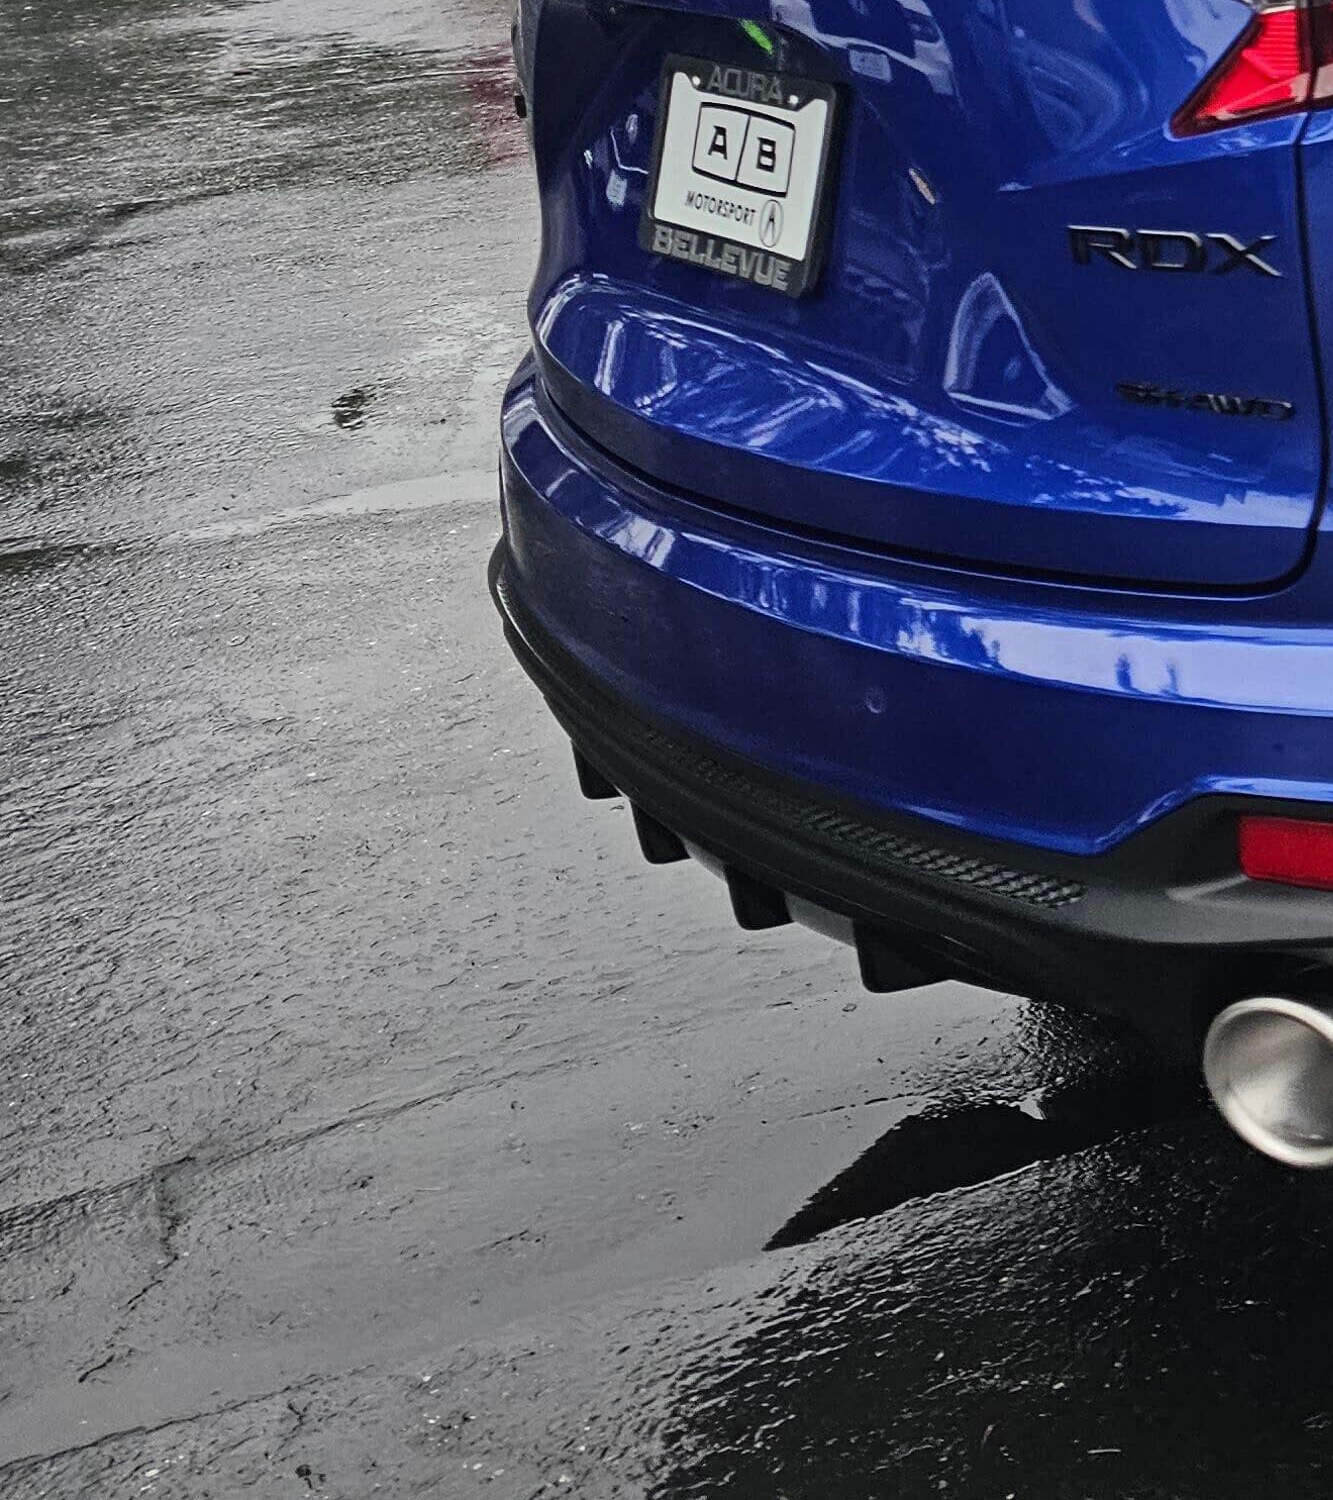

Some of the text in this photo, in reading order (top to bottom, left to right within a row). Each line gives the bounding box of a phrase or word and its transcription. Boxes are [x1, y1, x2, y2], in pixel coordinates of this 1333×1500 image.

[707, 65, 783, 104] ACURA
[684, 190, 757, 227] MOTORSPORT
[652, 224, 791, 291] BELLEVUE
[1067, 224, 1285, 277] RDX
